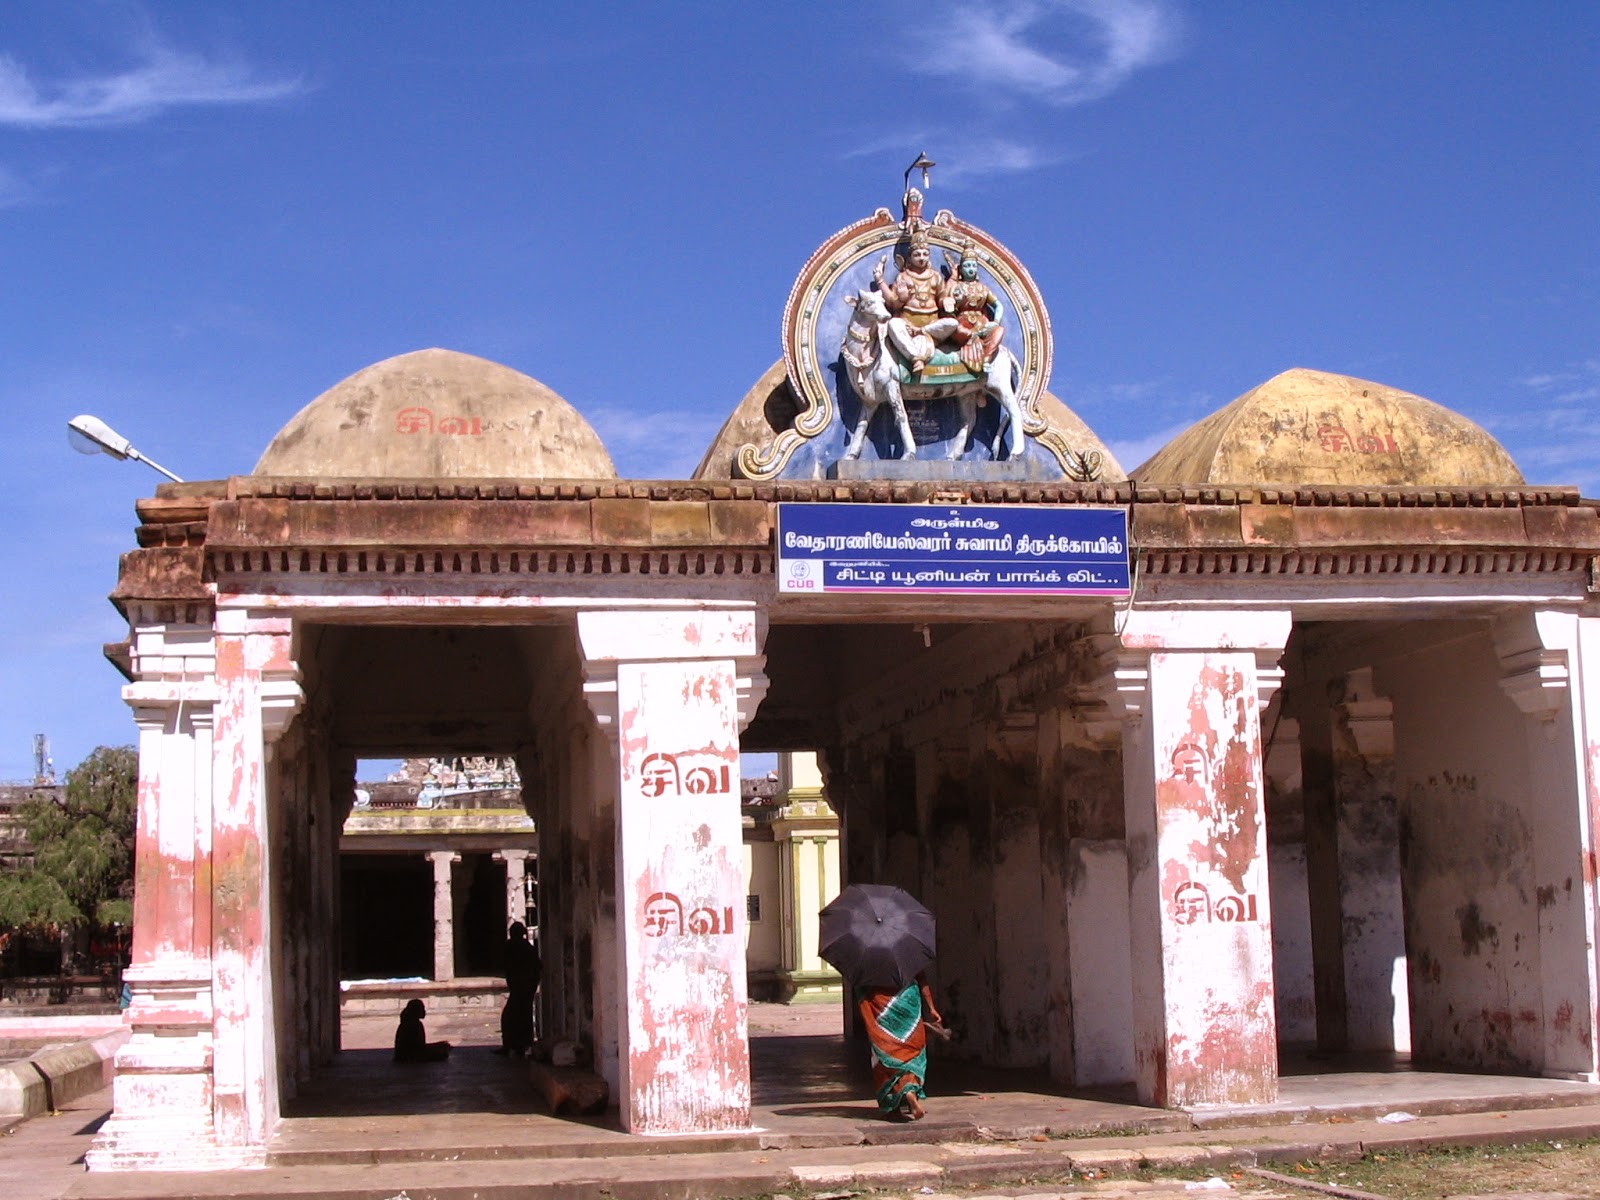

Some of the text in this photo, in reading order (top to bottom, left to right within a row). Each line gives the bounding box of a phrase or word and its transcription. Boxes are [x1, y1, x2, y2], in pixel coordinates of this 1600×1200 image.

[396, 406, 482, 436] சிவ
[1316, 423, 1398, 454] சிவ
[910, 517, 1000, 530] அருள்மிகு
[785, 531, 1123, 556] வேதாரணியேஸ்வரர் சுவாமி திருக்கோயில்
[787, 579, 814, 589] CUB
[836, 567, 886, 585] சிட்டி
[892, 569, 991, 586] யூனியன்
[996, 569, 1061, 584] பாங்க்
[640, 752, 731, 798] சிவ
[643, 891, 735, 938] சிவ
[1173, 881, 1258, 926] சிவ
